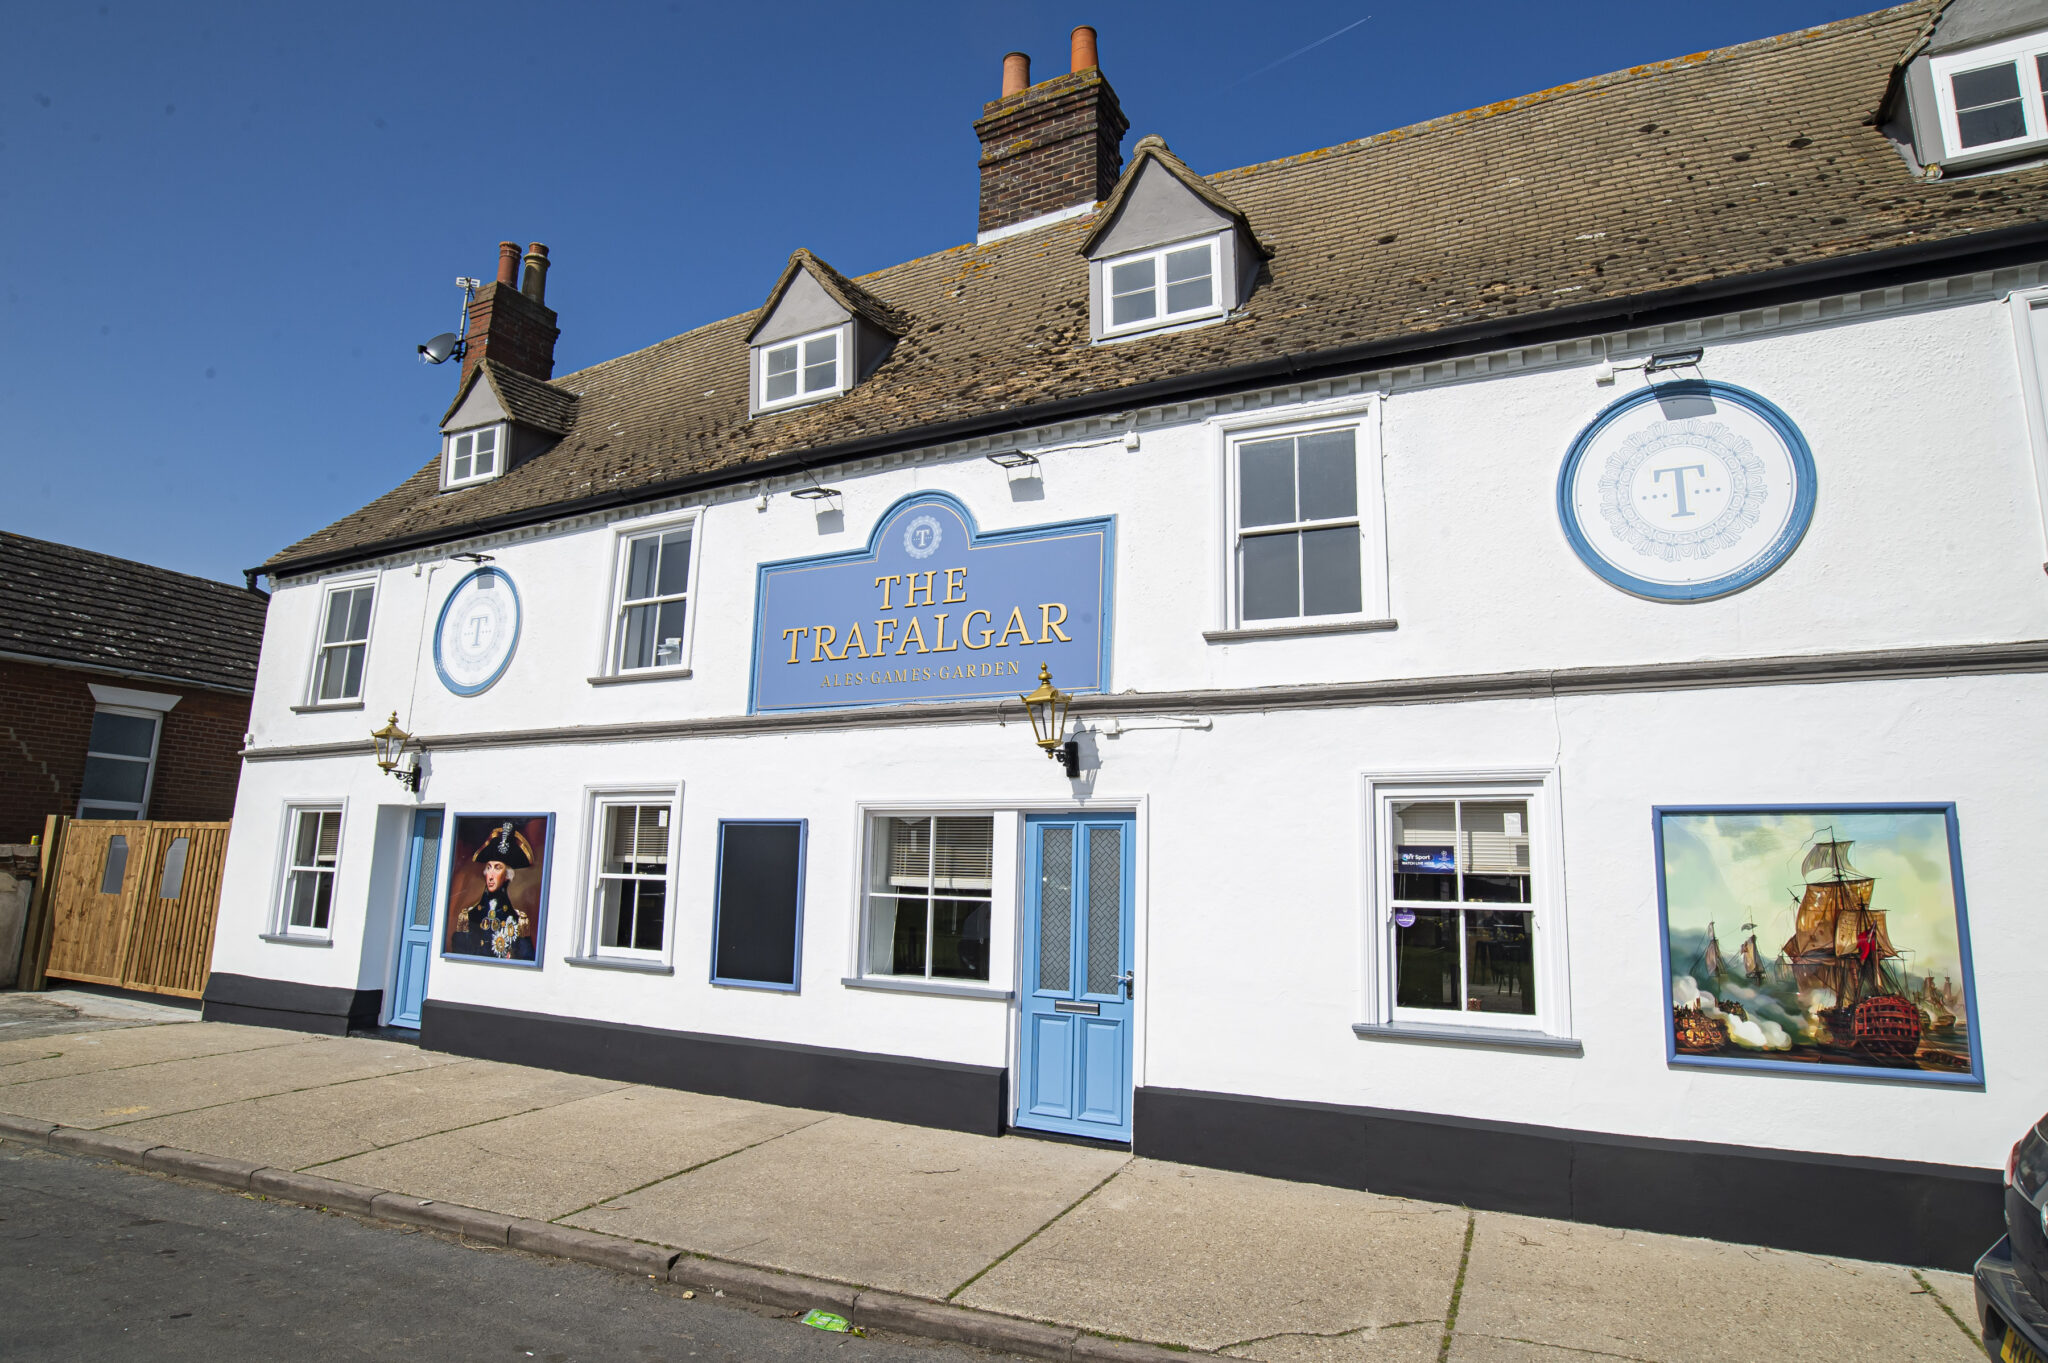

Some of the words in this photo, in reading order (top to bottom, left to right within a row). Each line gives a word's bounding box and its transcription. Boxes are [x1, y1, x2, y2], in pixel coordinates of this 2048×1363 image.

[1653, 464, 1706, 518] T
[915, 529, 930, 547] T
[874, 567, 968, 611] THE
[470, 616, 488, 646] T
[782, 602, 1073, 664] TRAFALGAR
